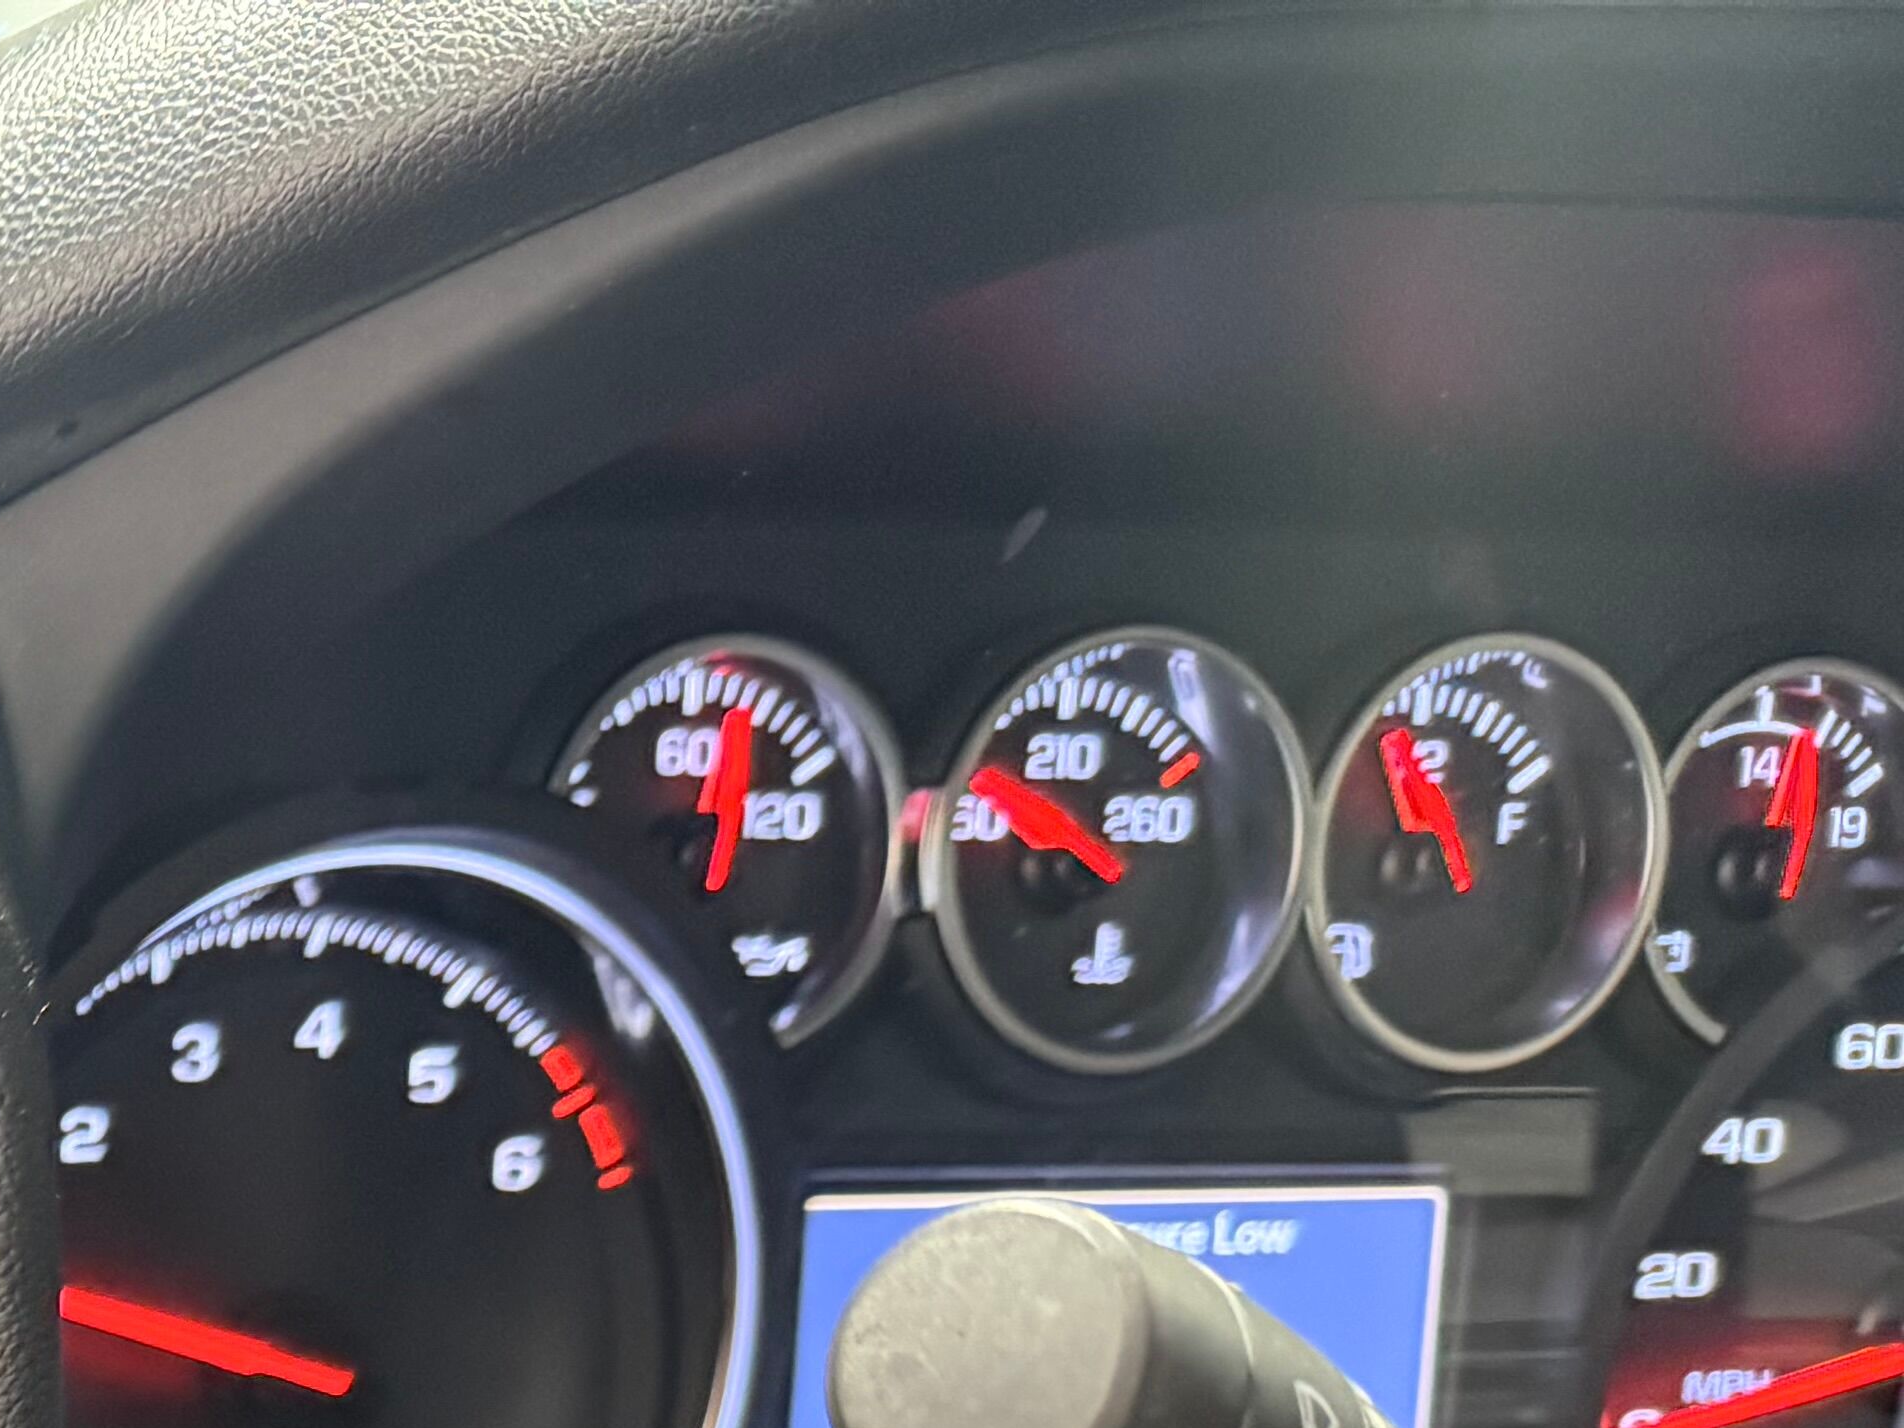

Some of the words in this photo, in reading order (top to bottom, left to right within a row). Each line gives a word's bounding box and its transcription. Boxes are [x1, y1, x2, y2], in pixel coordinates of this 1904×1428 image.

[1025, 733, 1101, 780] 210
[1103, 795, 1193, 842] 260
[1496, 802, 1529, 845] F
[1828, 806, 1869, 849] 19
[171, 1022, 221, 1083] 3
[294, 1001, 346, 1059] 4
[1836, 1023, 1904, 1070] 60
[408, 1045, 459, 1104] 5
[59, 1106, 110, 1164] 2
[1702, 1118, 1785, 1164] 40
[492, 1135, 544, 1193] 6
[1213, 1209, 1298, 1256] Low
[1634, 1252, 1718, 1299] 20
